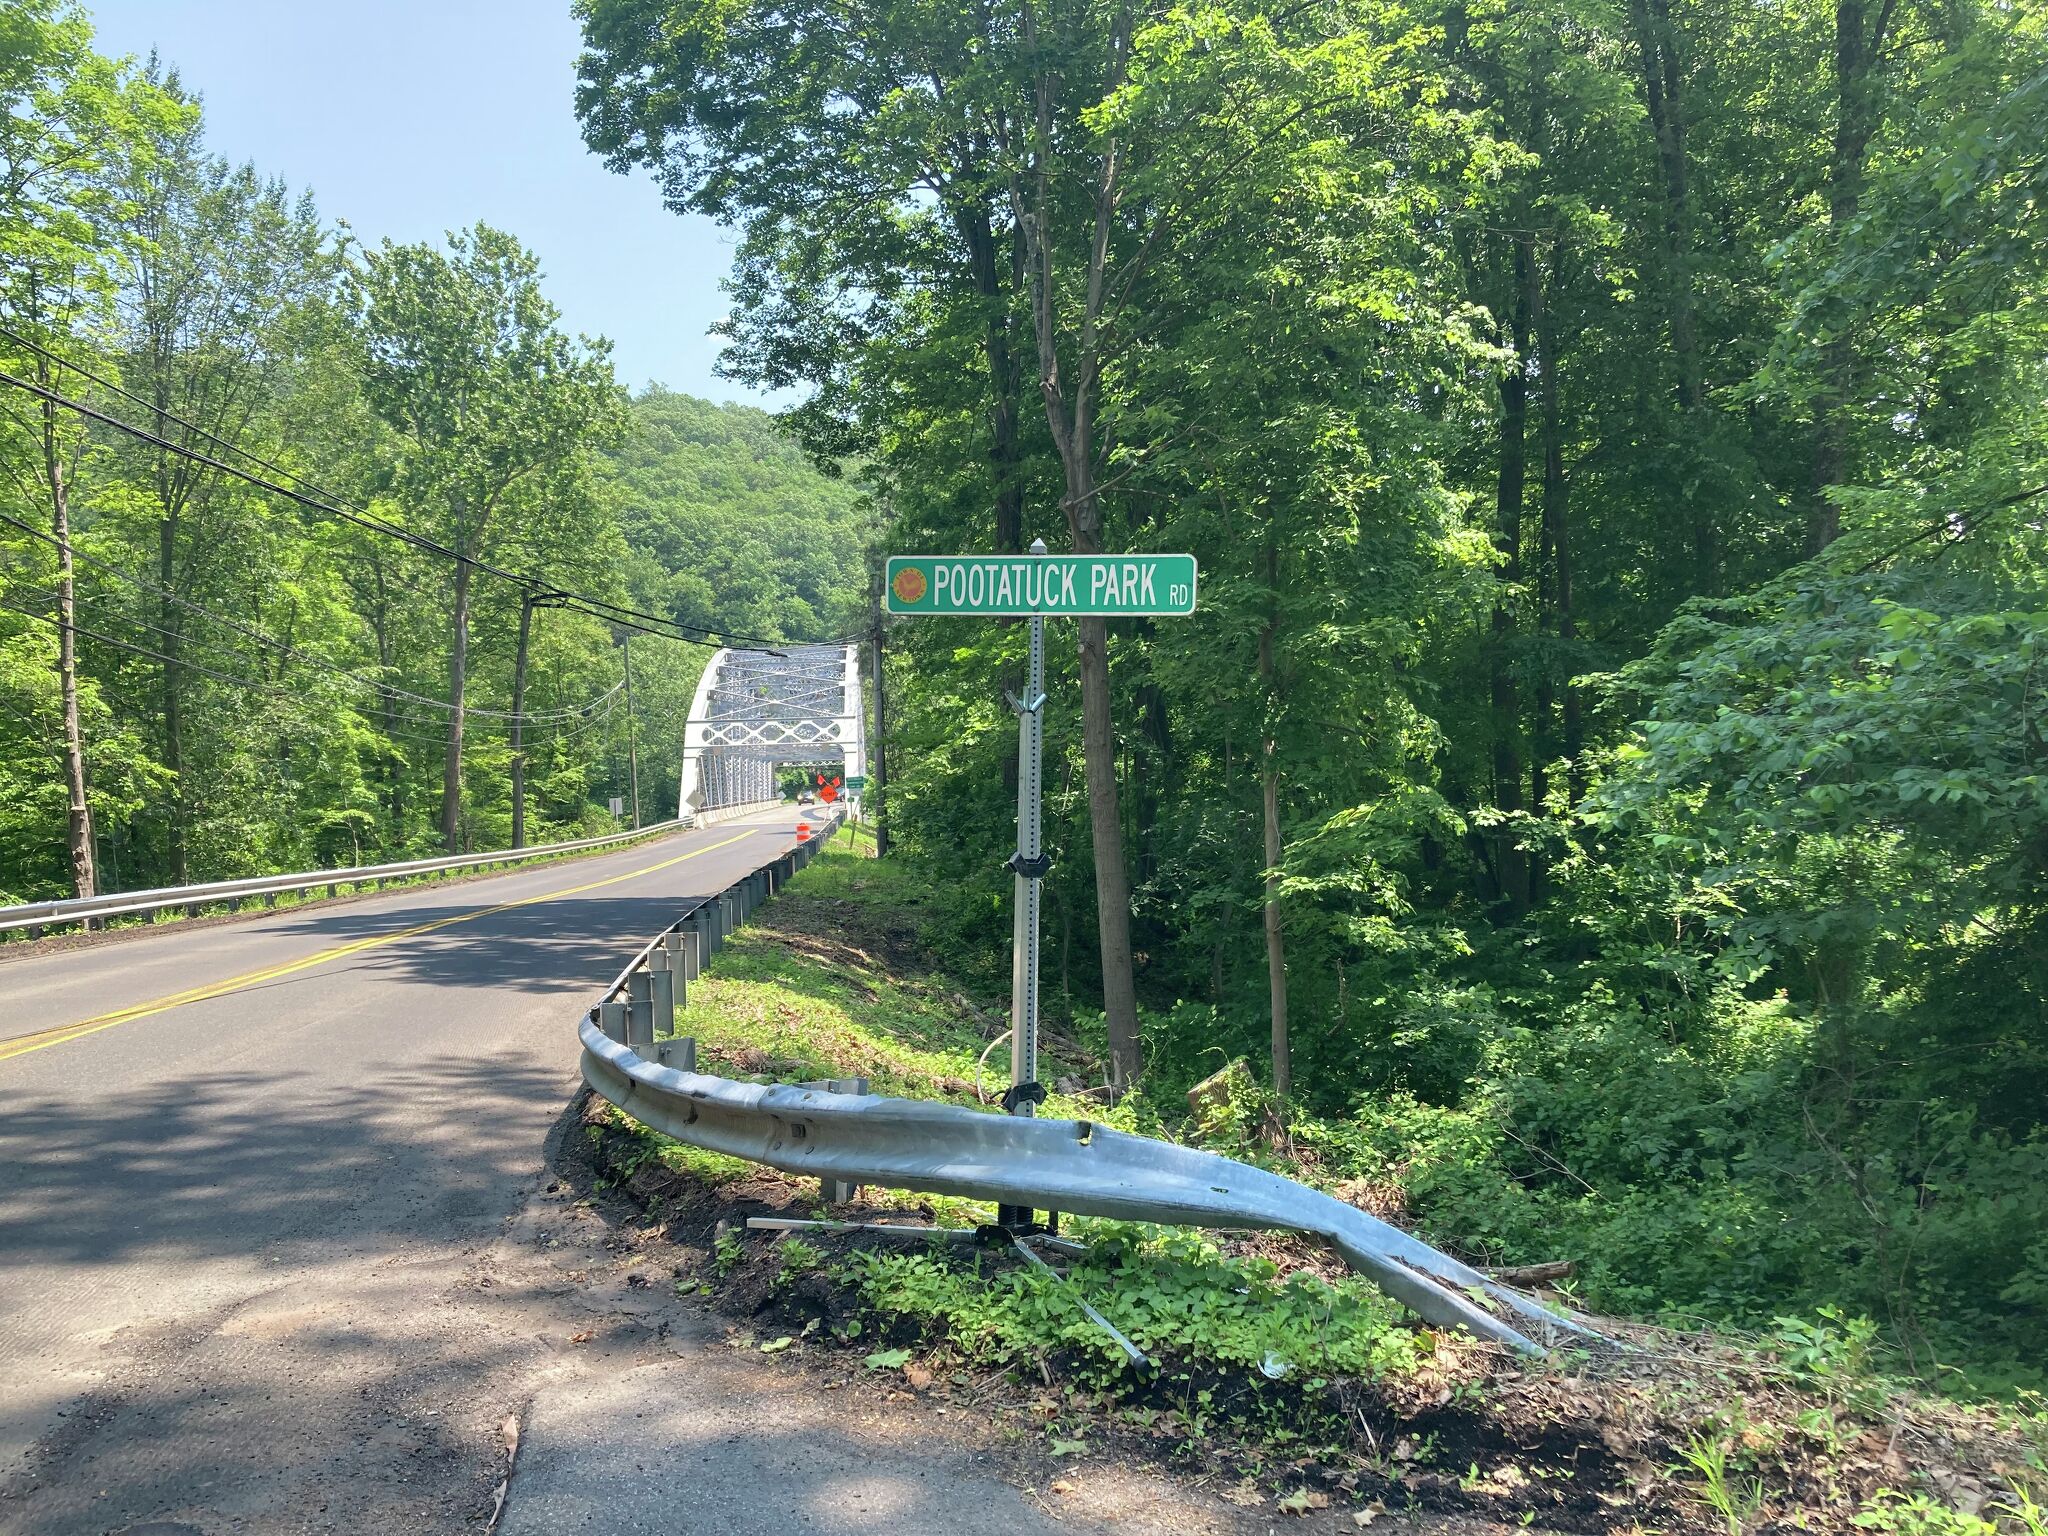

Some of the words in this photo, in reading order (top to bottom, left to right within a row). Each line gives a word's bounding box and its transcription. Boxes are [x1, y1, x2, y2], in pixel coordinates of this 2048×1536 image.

[935, 564, 1076, 606] POOTATUCK
[1091, 564, 1156, 605] PARK
[1170, 585, 1187, 605] RD
